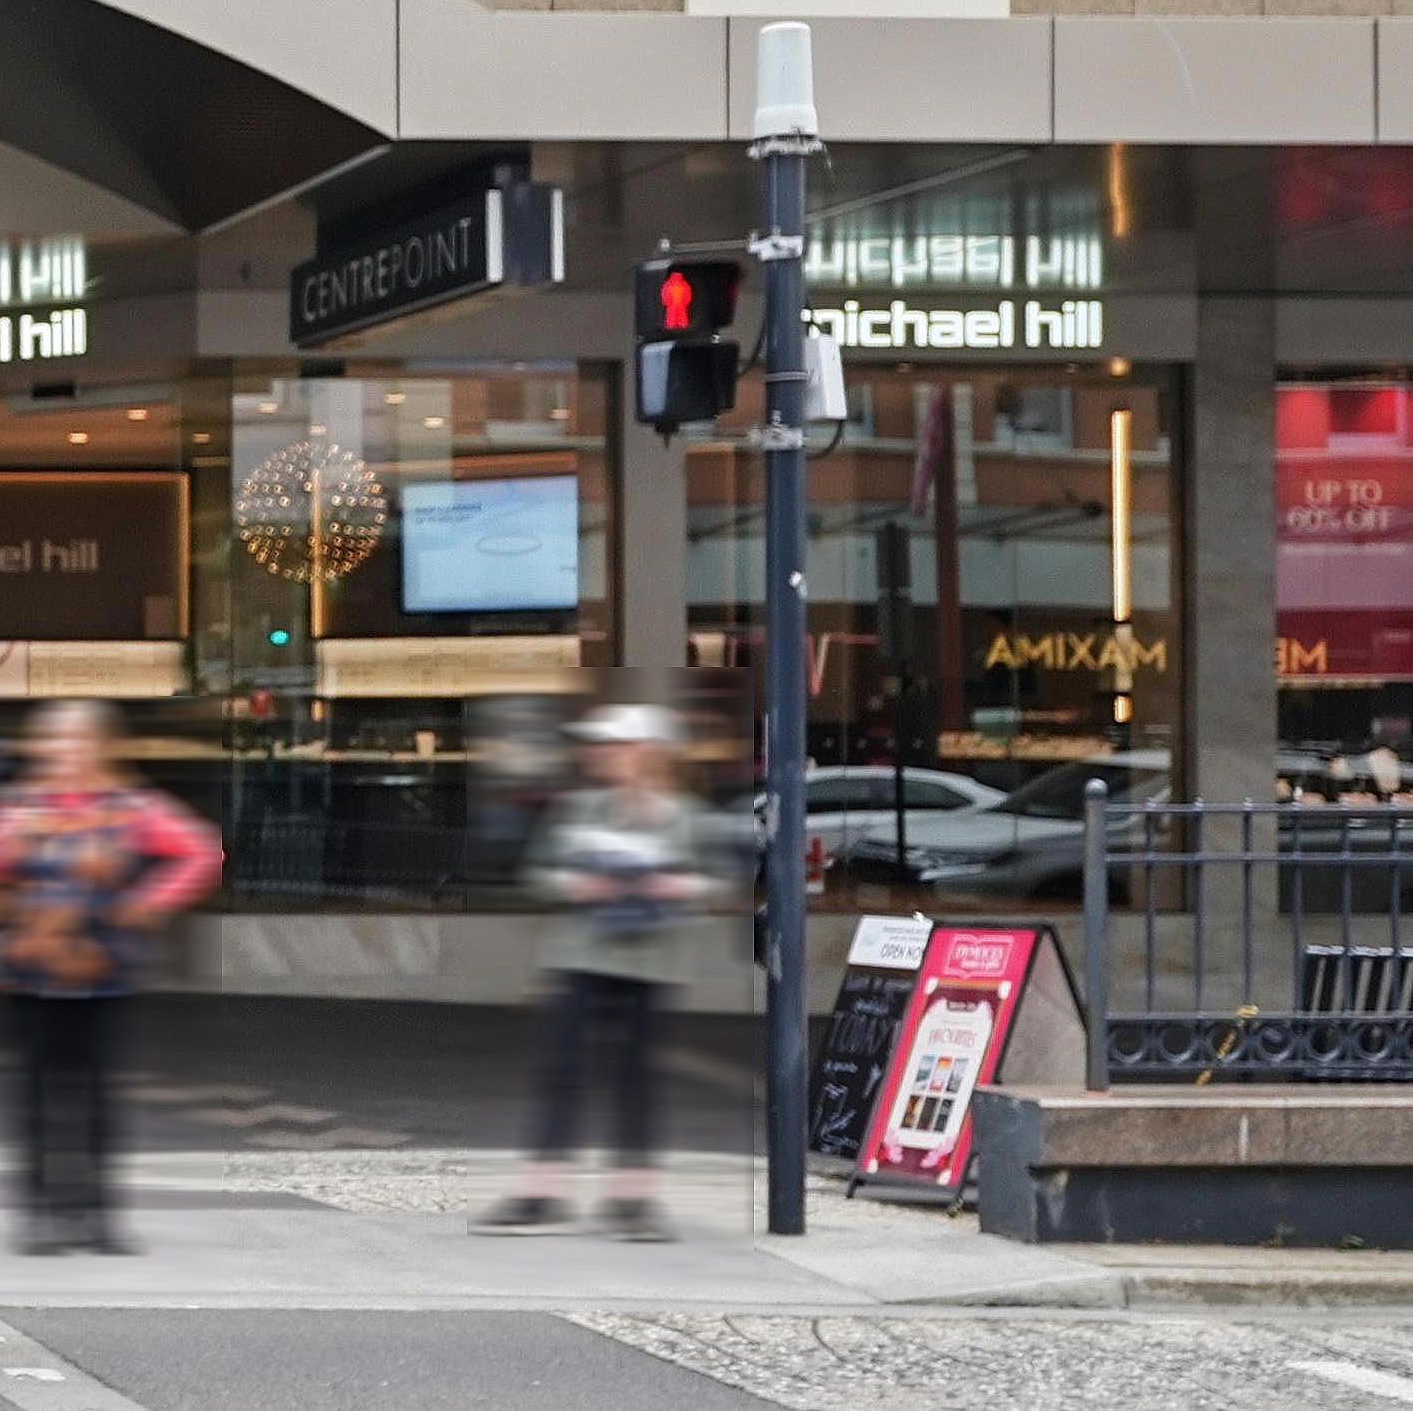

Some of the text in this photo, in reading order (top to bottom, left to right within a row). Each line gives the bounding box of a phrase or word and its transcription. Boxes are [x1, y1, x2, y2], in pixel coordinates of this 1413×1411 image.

[302, 216, 472, 324] CENTREPOINT
[19, 307, 86, 360] hill
[1026, 300, 1103, 347] hill
[1347, 479, 1384, 505] TO
[42, 538, 98, 572] hill
